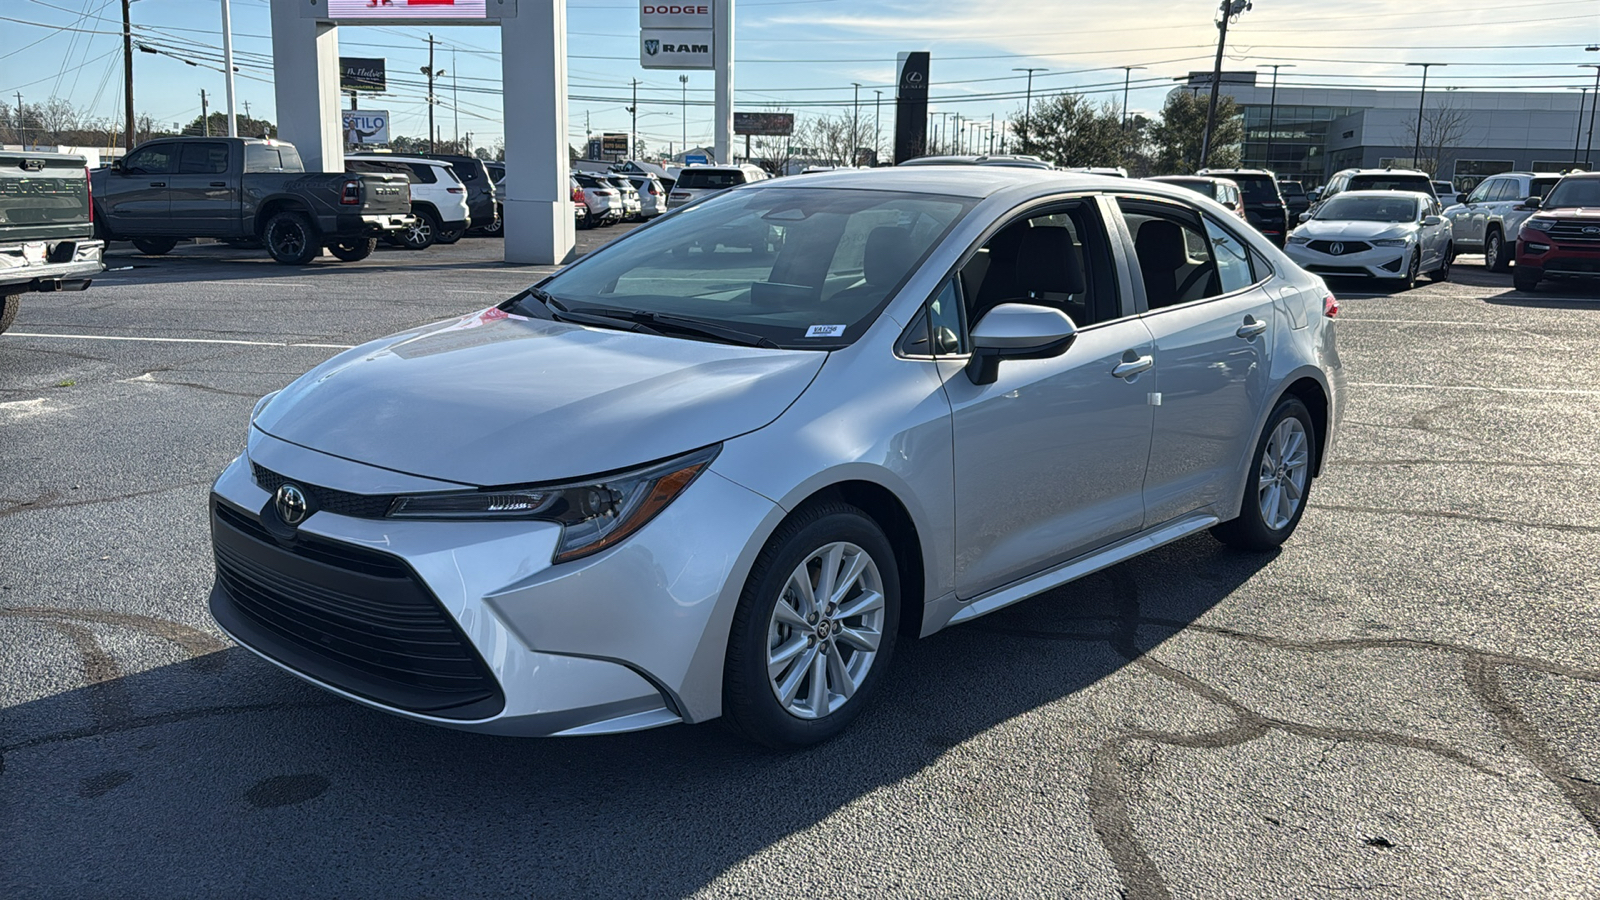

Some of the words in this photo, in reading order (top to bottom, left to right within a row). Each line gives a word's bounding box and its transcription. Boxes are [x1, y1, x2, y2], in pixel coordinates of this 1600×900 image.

[643, 6, 708, 14] DODGE
[662, 44, 708, 53] RAM
[342, 117, 384, 129] STILO
[375, 187, 399, 195] RAM
